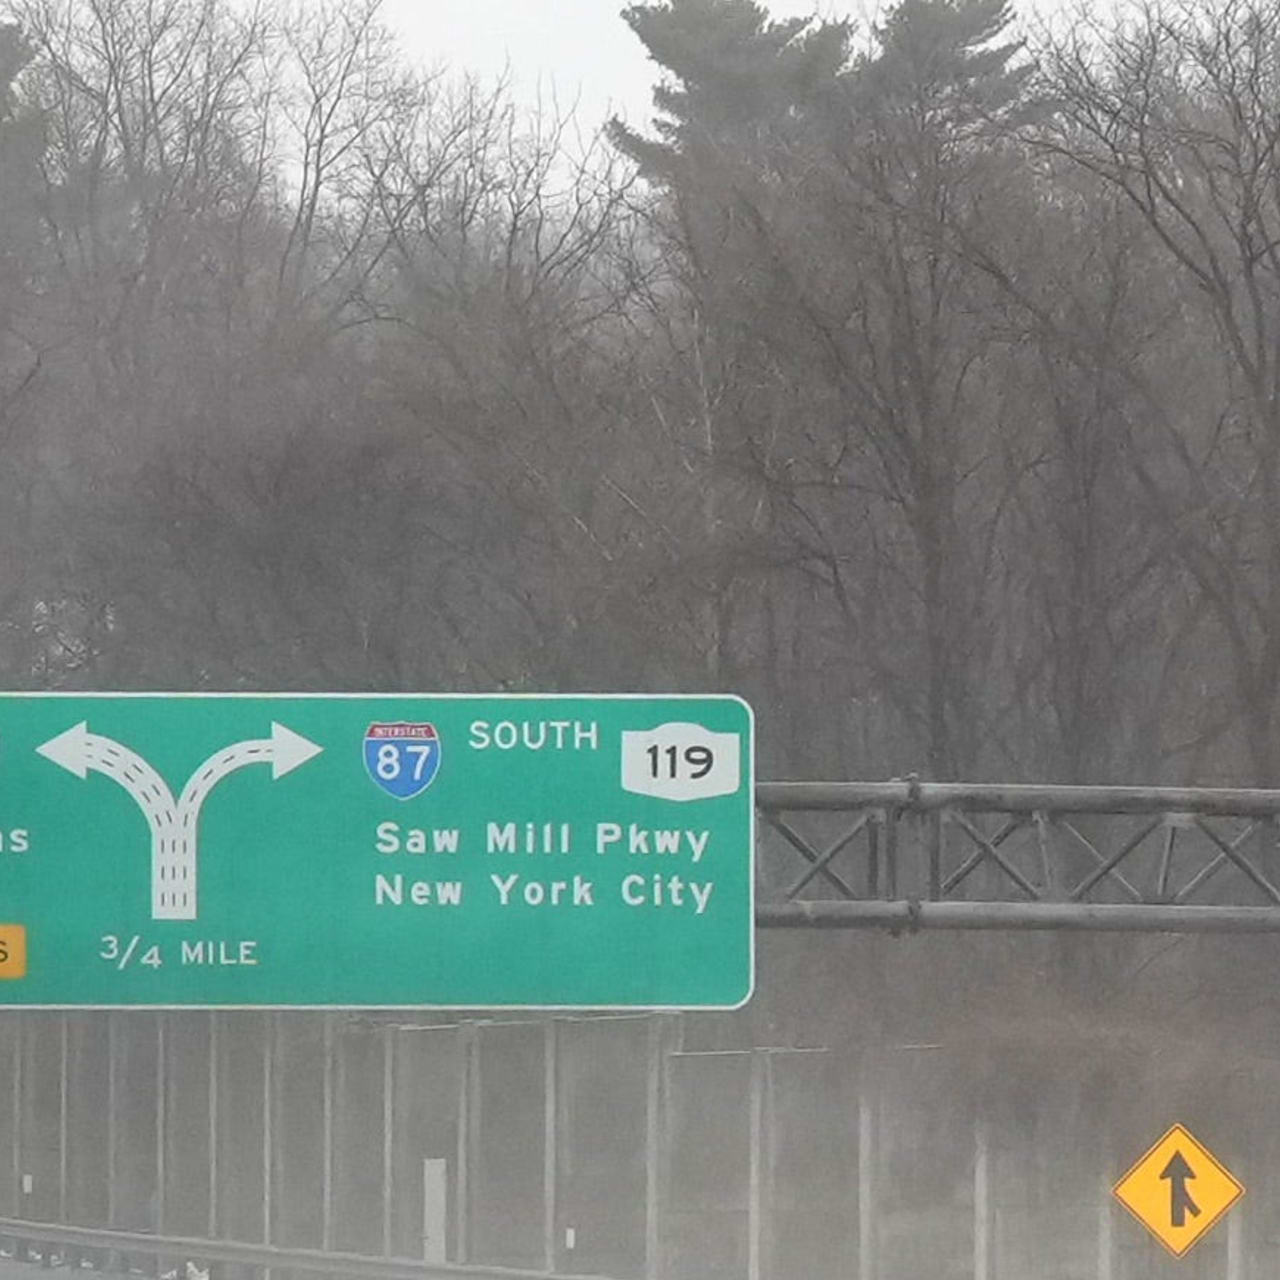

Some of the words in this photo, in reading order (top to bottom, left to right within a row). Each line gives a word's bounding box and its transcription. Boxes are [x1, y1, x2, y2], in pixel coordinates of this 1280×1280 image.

[468, 720, 600, 750] SOUTH
[376, 744, 431, 781] 87
[646, 744, 715, 780] 119
[375, 822, 461, 854] Saw
[486, 822, 570, 854] Mill
[595, 822, 711, 863] Pkwy
[374, 874, 464, 906] New
[490, 874, 595, 906] York
[621, 874, 715, 915] City
[98, 935, 163, 970] 3/4
[181, 941, 258, 965] MILE
